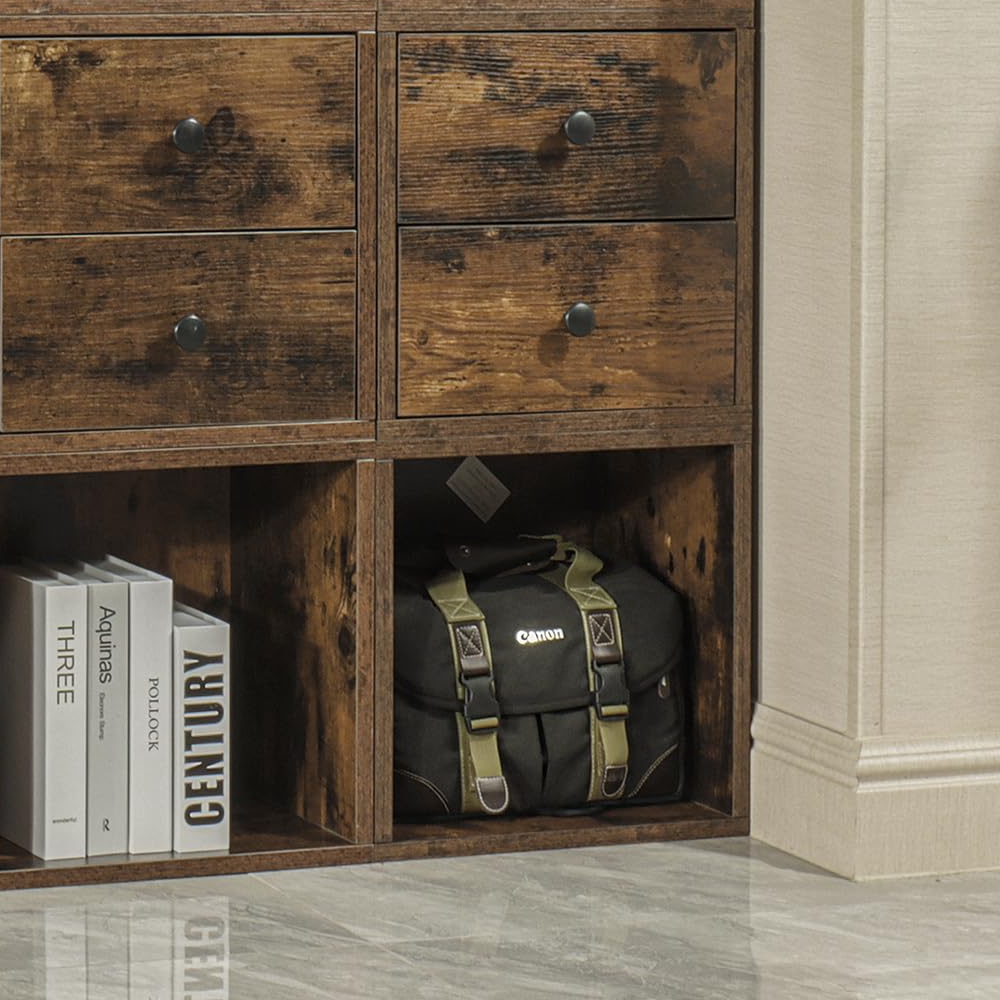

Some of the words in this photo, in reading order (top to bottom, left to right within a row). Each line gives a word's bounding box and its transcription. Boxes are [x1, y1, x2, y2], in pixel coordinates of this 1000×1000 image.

[57, 619, 75, 705] THREE
[95, 605, 116, 684] Aquinas
[516, 628, 564, 645] Canon
[148, 677, 159, 751] POLLOCK
[184, 650, 225, 827] CENTURY
